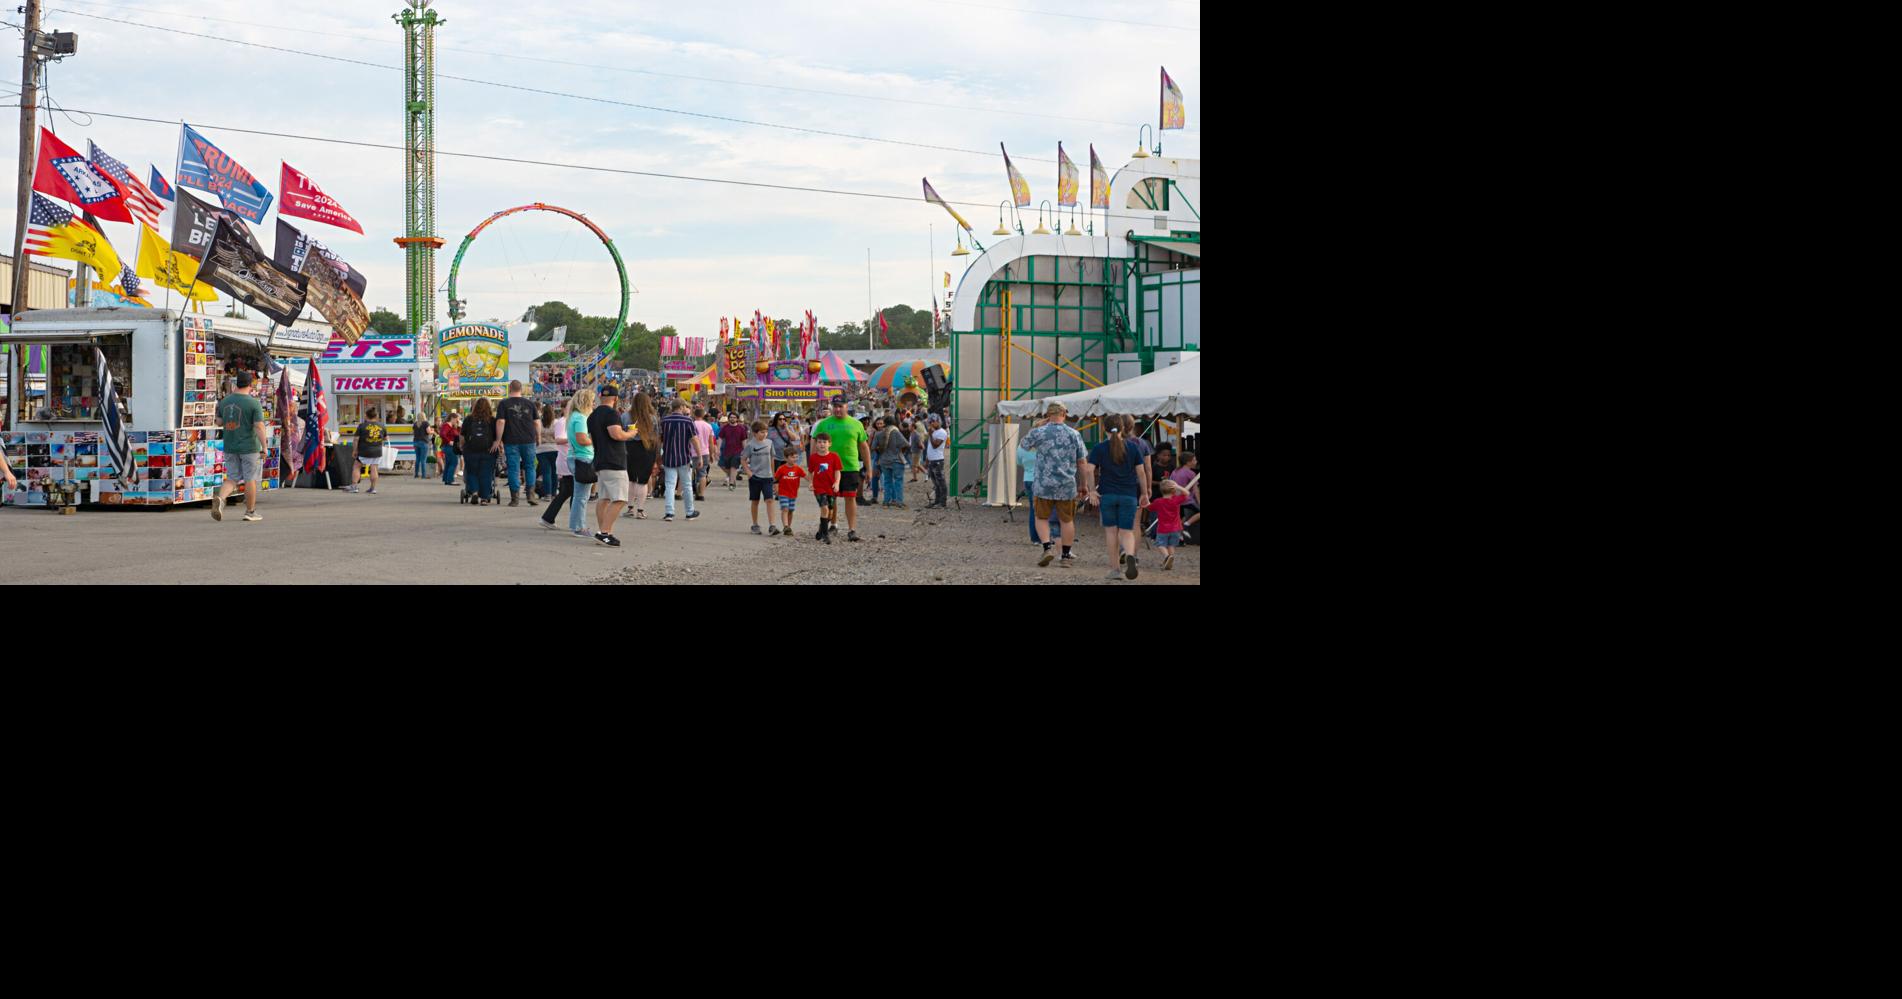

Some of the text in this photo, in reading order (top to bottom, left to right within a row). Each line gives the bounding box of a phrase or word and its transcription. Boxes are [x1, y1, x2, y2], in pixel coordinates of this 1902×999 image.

[295, 200, 317, 212] Save
[442, 325, 505, 342] LEMONADE
[335, 377, 408, 390] TICKETS
